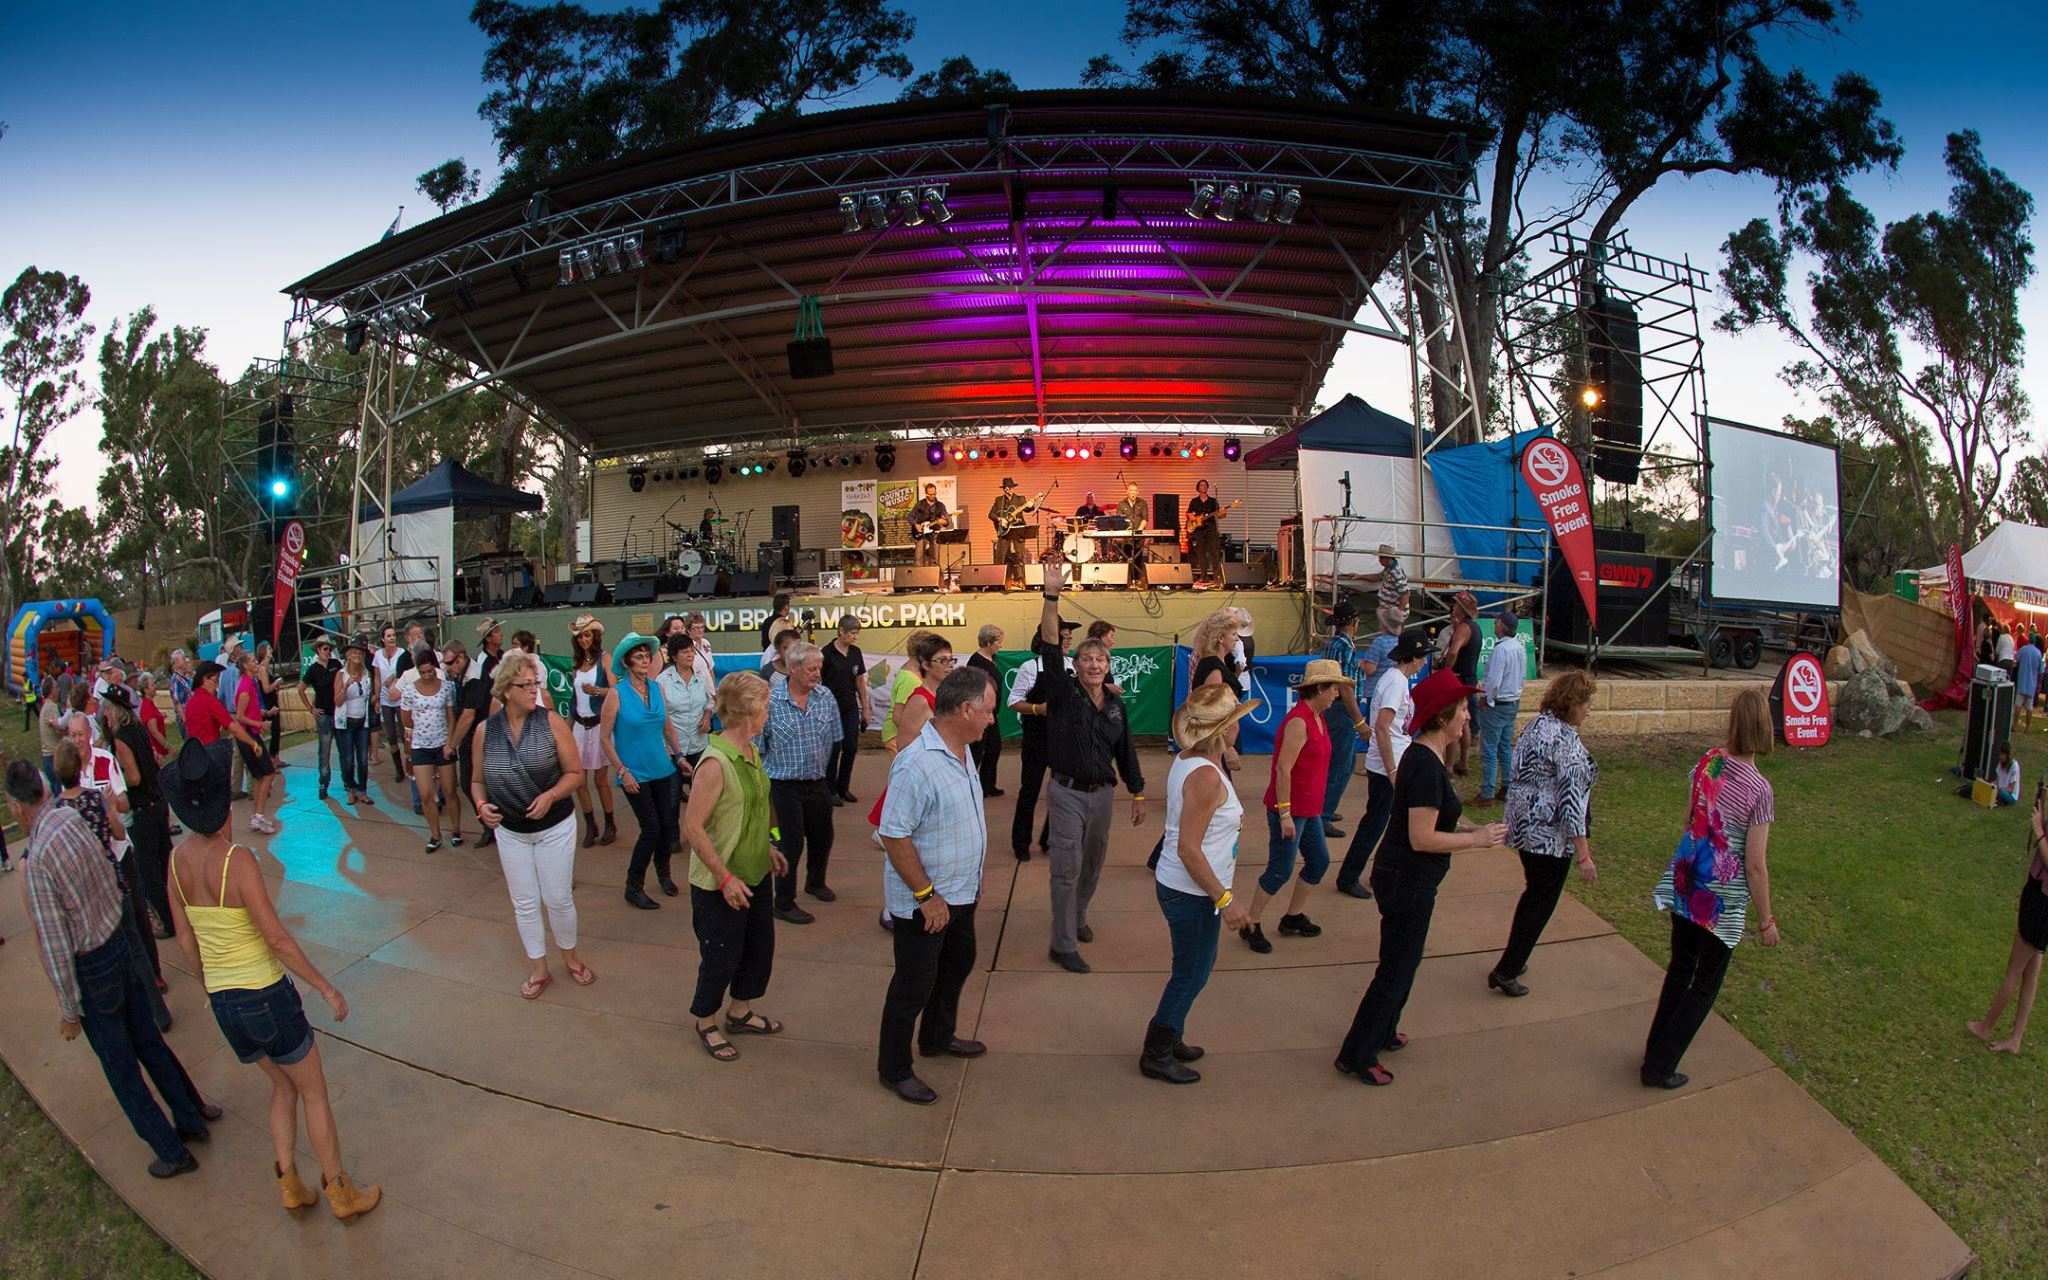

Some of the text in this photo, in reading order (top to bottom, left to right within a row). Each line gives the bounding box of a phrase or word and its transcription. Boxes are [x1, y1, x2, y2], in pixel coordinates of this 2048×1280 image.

[1539, 483, 1581, 507] Smoke
[1551, 502, 1579, 519] Free
[1554, 512, 1589, 536] Event
[1990, 583, 2010, 600] HOT
[899, 602, 966, 627] PARK
[1785, 714, 1827, 726] Smoke Free
[1797, 727, 1818, 738] Event
